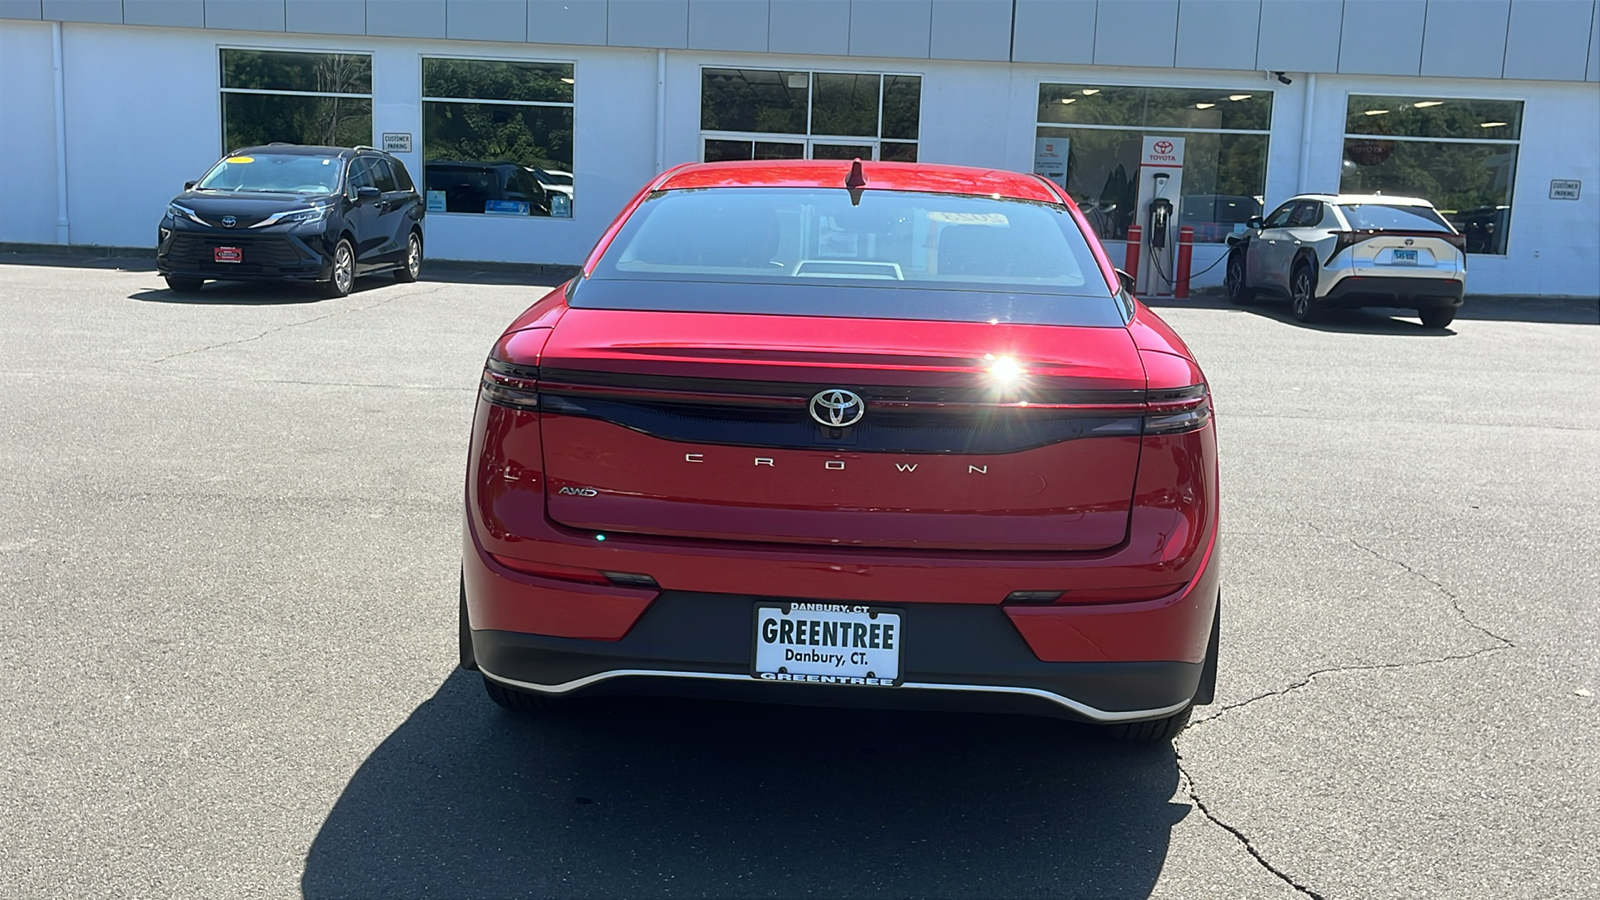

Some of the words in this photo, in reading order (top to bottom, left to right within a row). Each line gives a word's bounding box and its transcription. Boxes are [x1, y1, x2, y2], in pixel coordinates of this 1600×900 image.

[685, 453, 988, 475] CROWN
[558, 486, 598, 497] AWD
[790, 602, 850, 613] DANBURY,
[853, 605, 870, 613] CT
[762, 617, 895, 650] GREENTREE
[785, 648, 846, 668] Danbury,
[850, 652, 868, 666] CT.
[760, 672, 894, 687] GREENTREE
